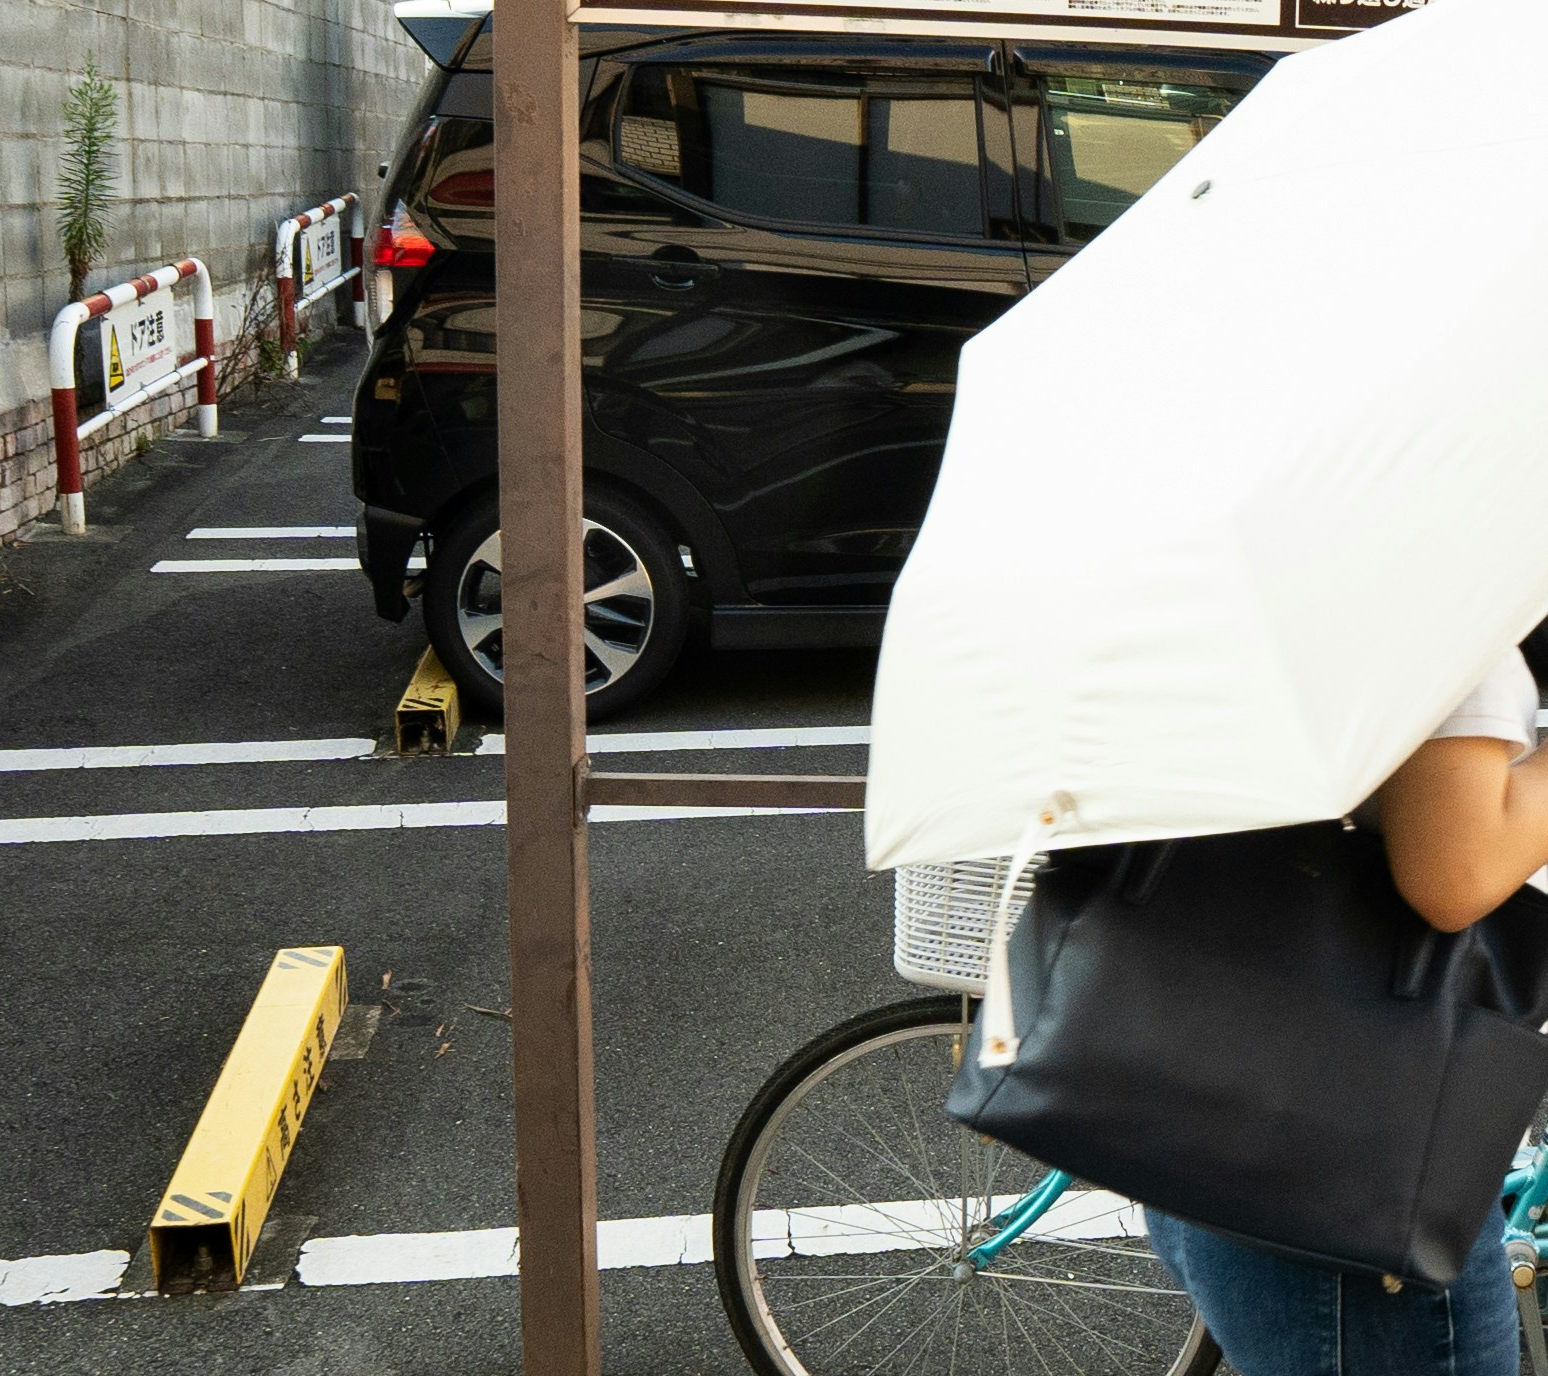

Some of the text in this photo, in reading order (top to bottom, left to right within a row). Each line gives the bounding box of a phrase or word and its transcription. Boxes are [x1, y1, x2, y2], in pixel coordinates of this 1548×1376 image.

[131, 310, 165, 356] ドア注意
[278, 1012, 327, 1162] 高さ注意
